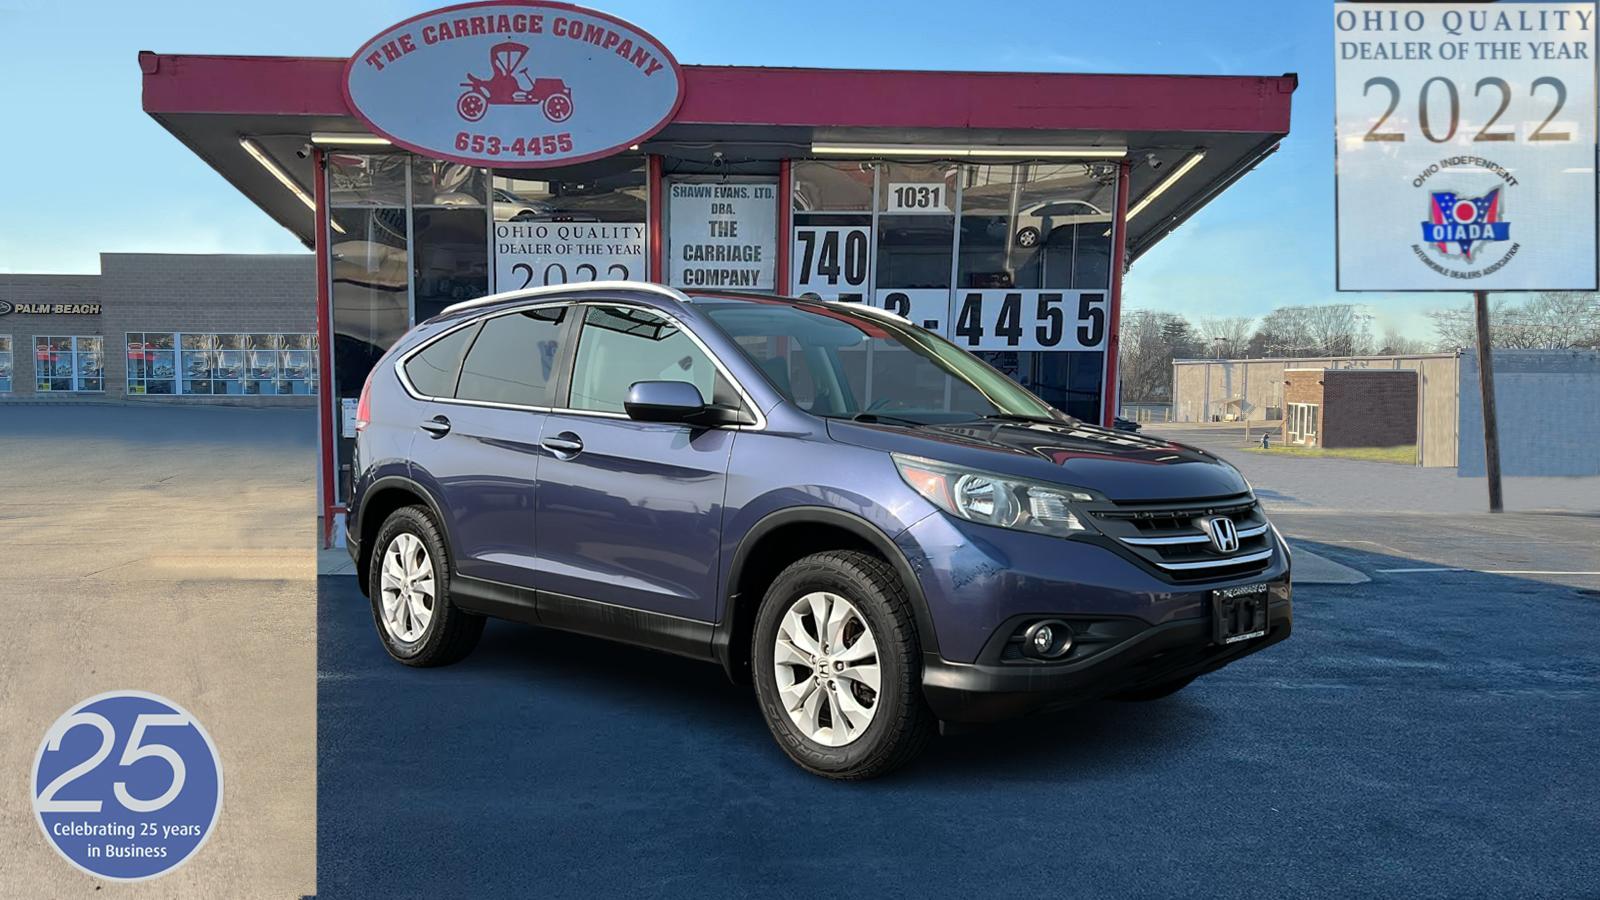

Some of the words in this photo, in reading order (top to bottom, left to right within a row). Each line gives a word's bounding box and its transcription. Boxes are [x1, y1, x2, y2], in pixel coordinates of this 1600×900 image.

[1336, 10, 1425, 31] OHIO
[1442, 10, 1593, 36] QUALITY
[366, 34, 416, 71] THE
[422, 15, 543, 45] CARRIAGE
[552, 17, 664, 77] COMPANY
[1340, 42, 1433, 60] DEALER
[1438, 42, 1469, 60] OF
[1474, 42, 1522, 60] THE
[1527, 42, 1589, 60] YEAR
[1362, 76, 1571, 143] 2022
[455, 132, 573, 157] 653-4455
[1412, 164, 1440, 188] OHIO
[1439, 156, 1519, 187] INDEPENDENT
[672, 186, 712, 198] SHAWN
[754, 187, 775, 199] LTD.
[894, 186, 941, 209] 1031
[711, 203, 736, 215] DBA.
[497, 226, 548, 239] OHIO
[557, 226, 644, 241] QUALITY
[708, 220, 738, 238] THE
[1432, 225, 1496, 241] OIADA
[499, 244, 552, 255] DEALER
[555, 244, 574, 255] OF
[576, 244, 603, 255] THE
[606, 244, 641, 255] YEAR
[682, 244, 762, 262] CARRIAGE
[797, 230, 868, 286] 740
[683, 268, 760, 286] COMPANY
[1449, 270, 1482, 280] DEALERS
[15, 304, 51, 314] PALM
[54, 304, 100, 314] BEACH
